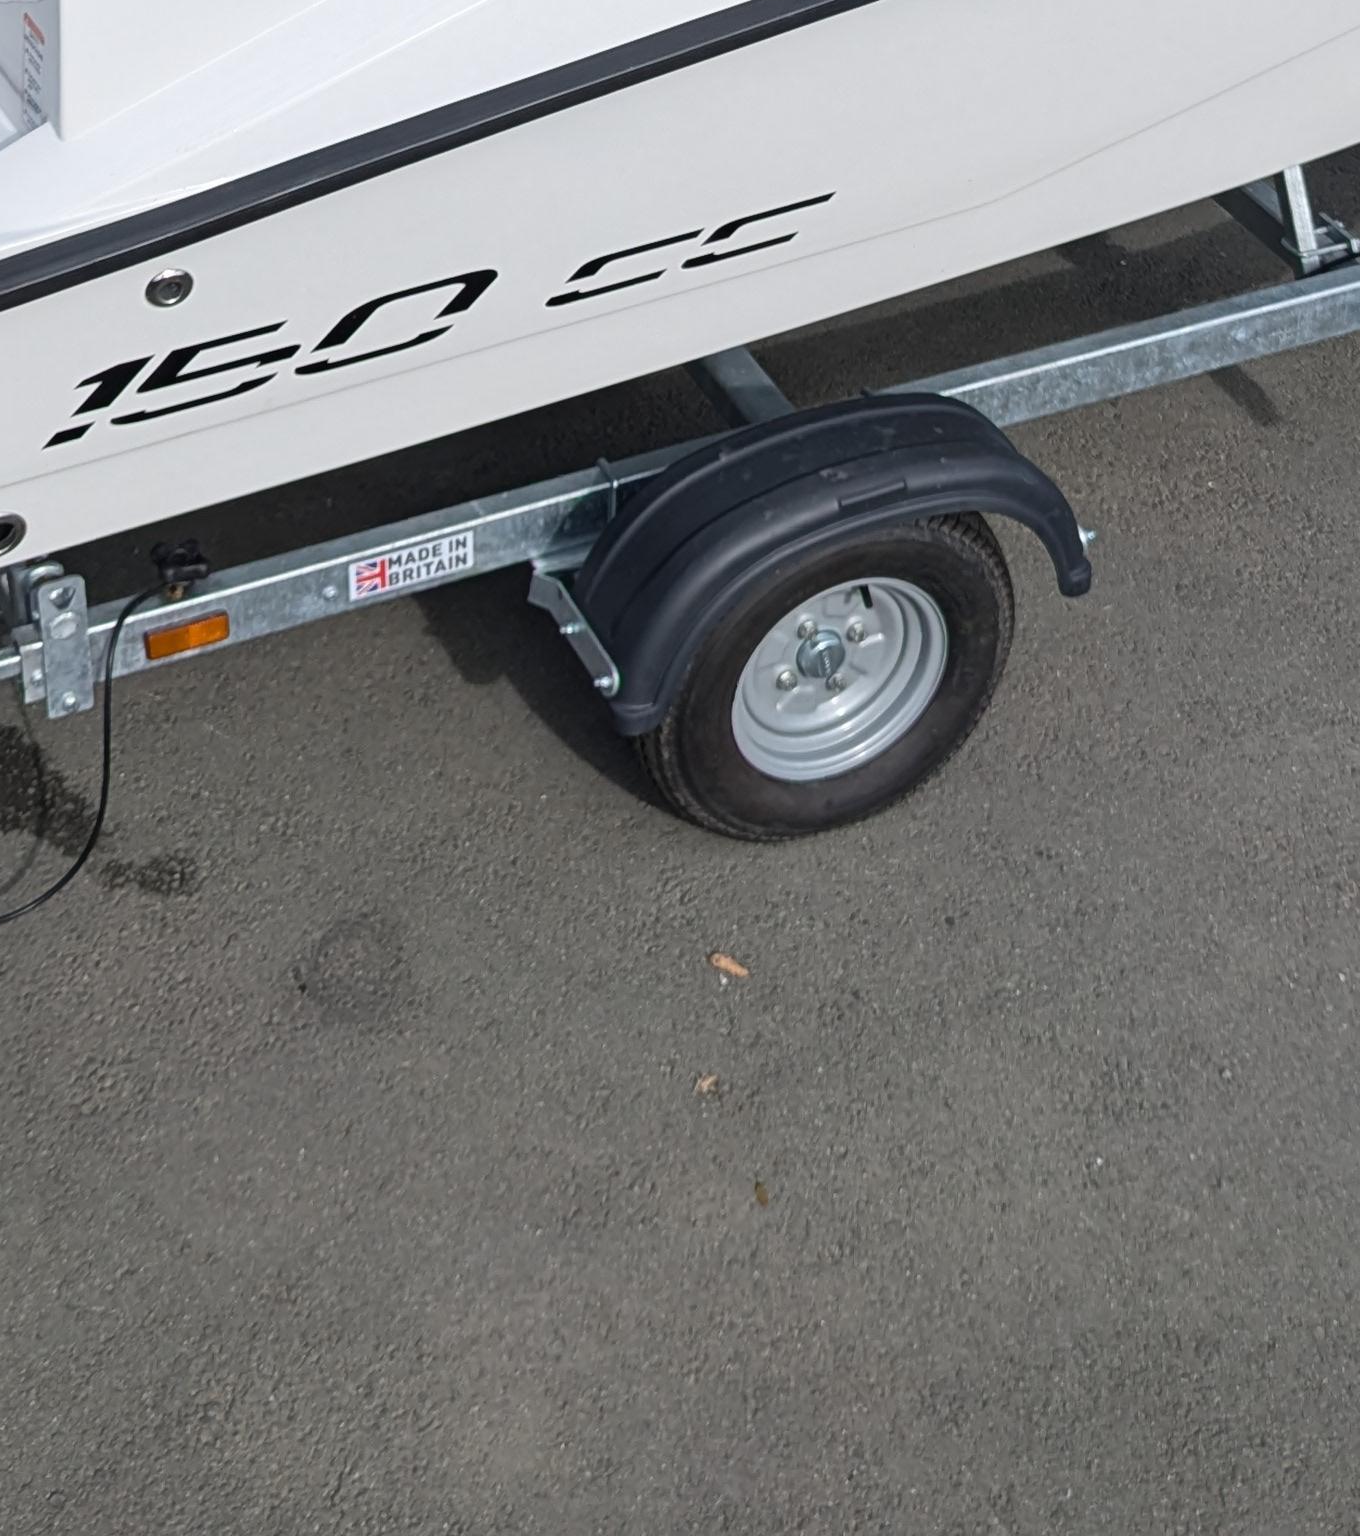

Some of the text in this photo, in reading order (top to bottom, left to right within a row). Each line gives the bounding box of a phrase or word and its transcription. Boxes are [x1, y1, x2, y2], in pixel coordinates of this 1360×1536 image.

[42, 268, 500, 450] 150
[388, 535, 468, 570] MADE IN
[388, 551, 468, 586] BRITAIN
